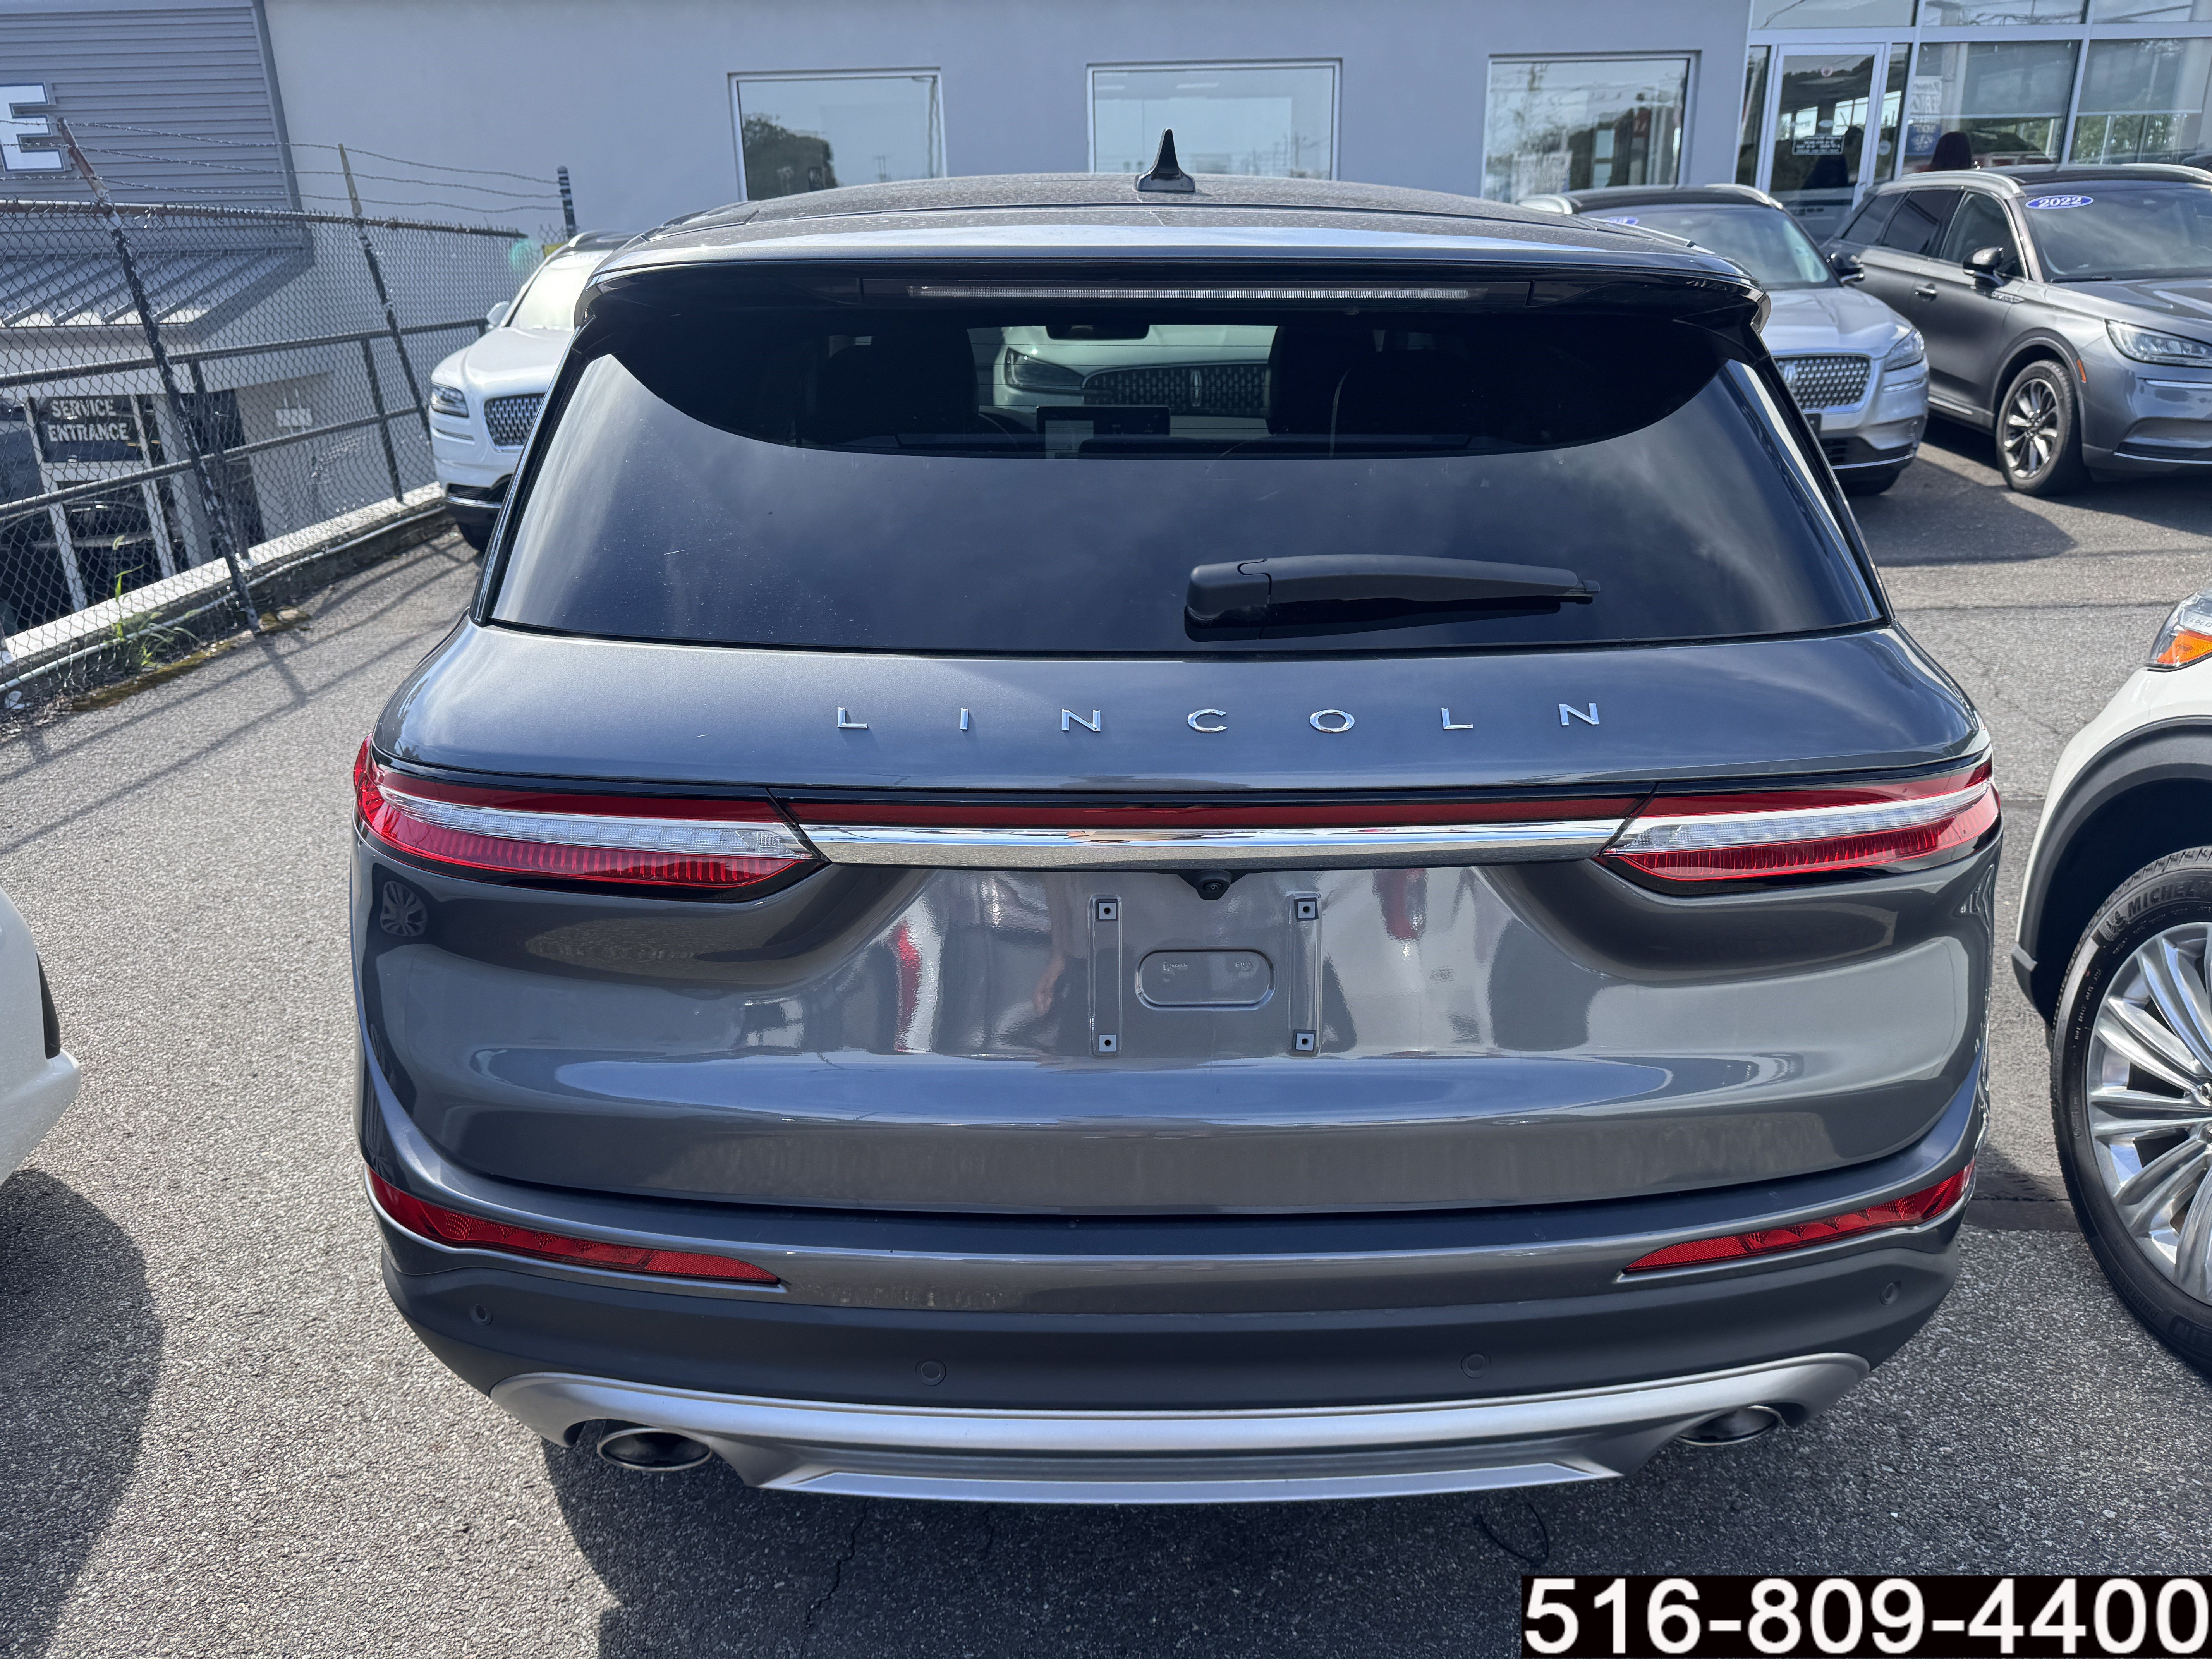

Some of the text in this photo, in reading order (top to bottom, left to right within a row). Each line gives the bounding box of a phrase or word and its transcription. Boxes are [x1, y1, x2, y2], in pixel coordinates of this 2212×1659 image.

[2038, 196, 2082, 208] 2022
[51, 399, 117, 418] SERVICE
[48, 423, 130, 442] ENTRANCE
[837, 703, 1599, 733] LINCOLN
